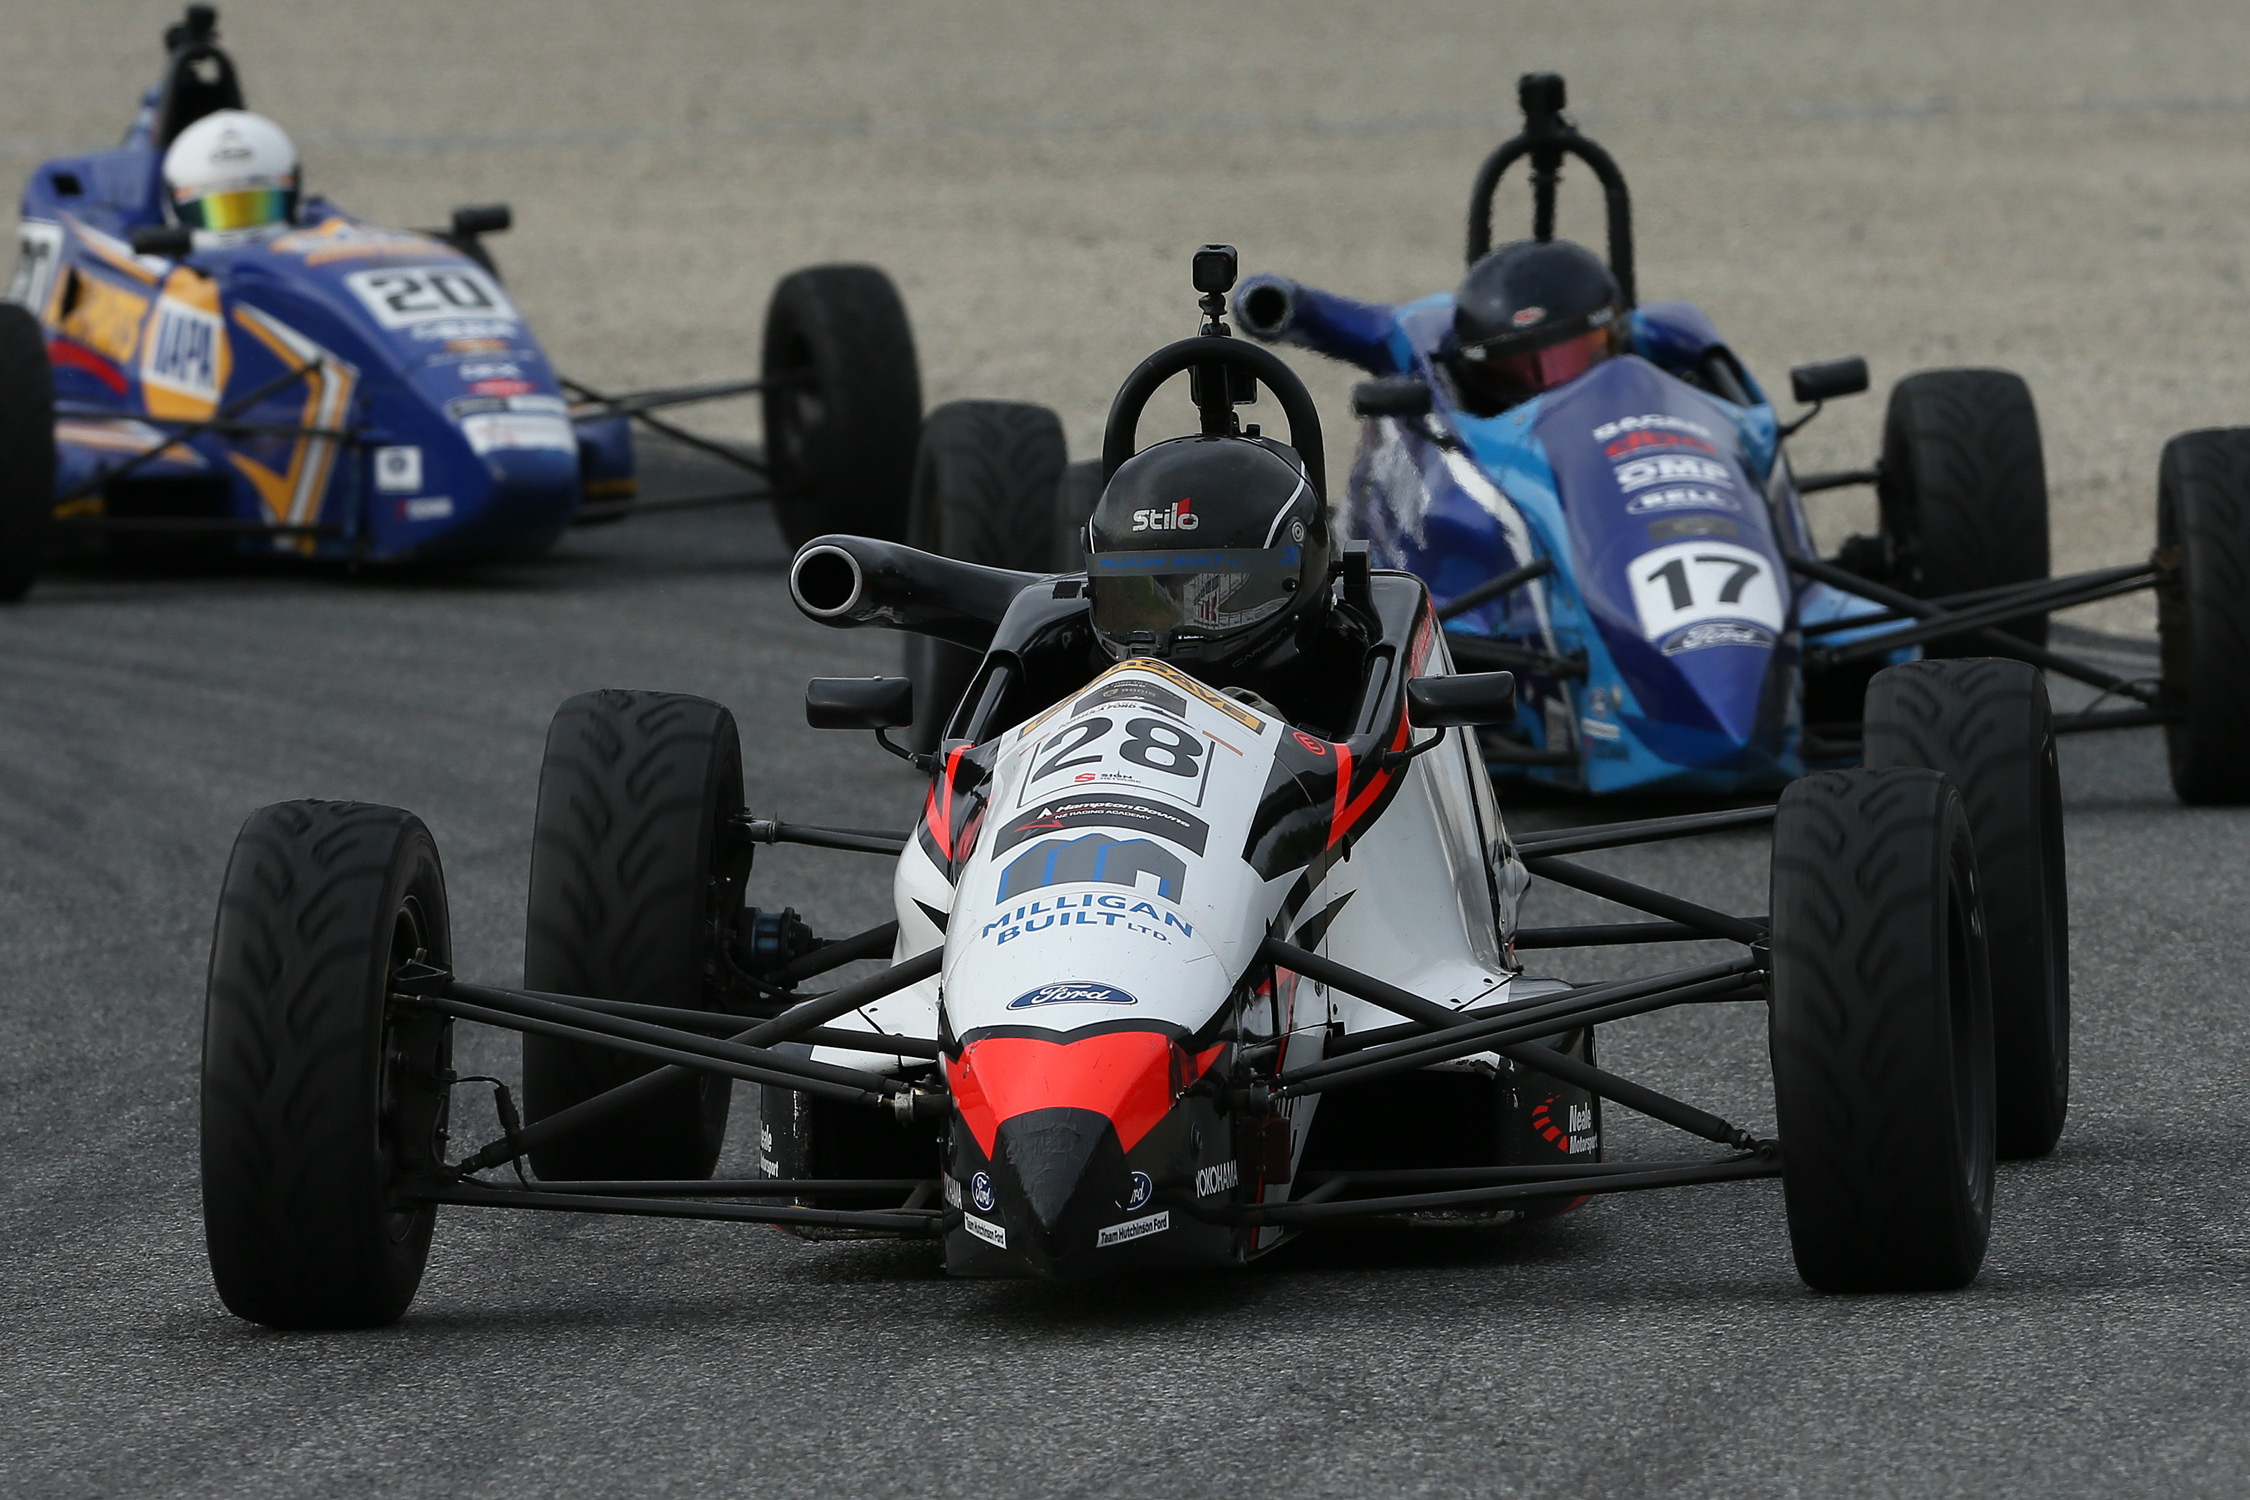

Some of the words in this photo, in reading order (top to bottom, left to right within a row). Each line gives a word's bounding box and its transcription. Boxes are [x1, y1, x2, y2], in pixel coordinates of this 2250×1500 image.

[369, 274, 493, 312] 20
[1616, 457, 1731, 484] OMP
[1132, 497, 1199, 532] Stilo
[1099, 555, 1166, 569] MILLIGAN
[1173, 553, 1224, 567] BUILT
[1647, 555, 1761, 611] 17
[1030, 716, 1204, 785] 28
[1054, 812, 1070, 820] NZ
[1070, 809, 1105, 817] RACING
[1105, 809, 1152, 821] ACADEMY
[982, 894, 1194, 939] MILLIGAN
[996, 911, 1126, 946] BUILT
[1126, 922, 1173, 945] LTD.
[1568, 1102, 1592, 1133] Neale
[1568, 1132, 1598, 1155] Motorsport
[1195, 1160, 1239, 1199] YOKOHAMA
[1100, 1230, 1119, 1245] Team
[1118, 1221, 1154, 1241] Hutchinson
[1153, 1215, 1168, 1231] Ford
